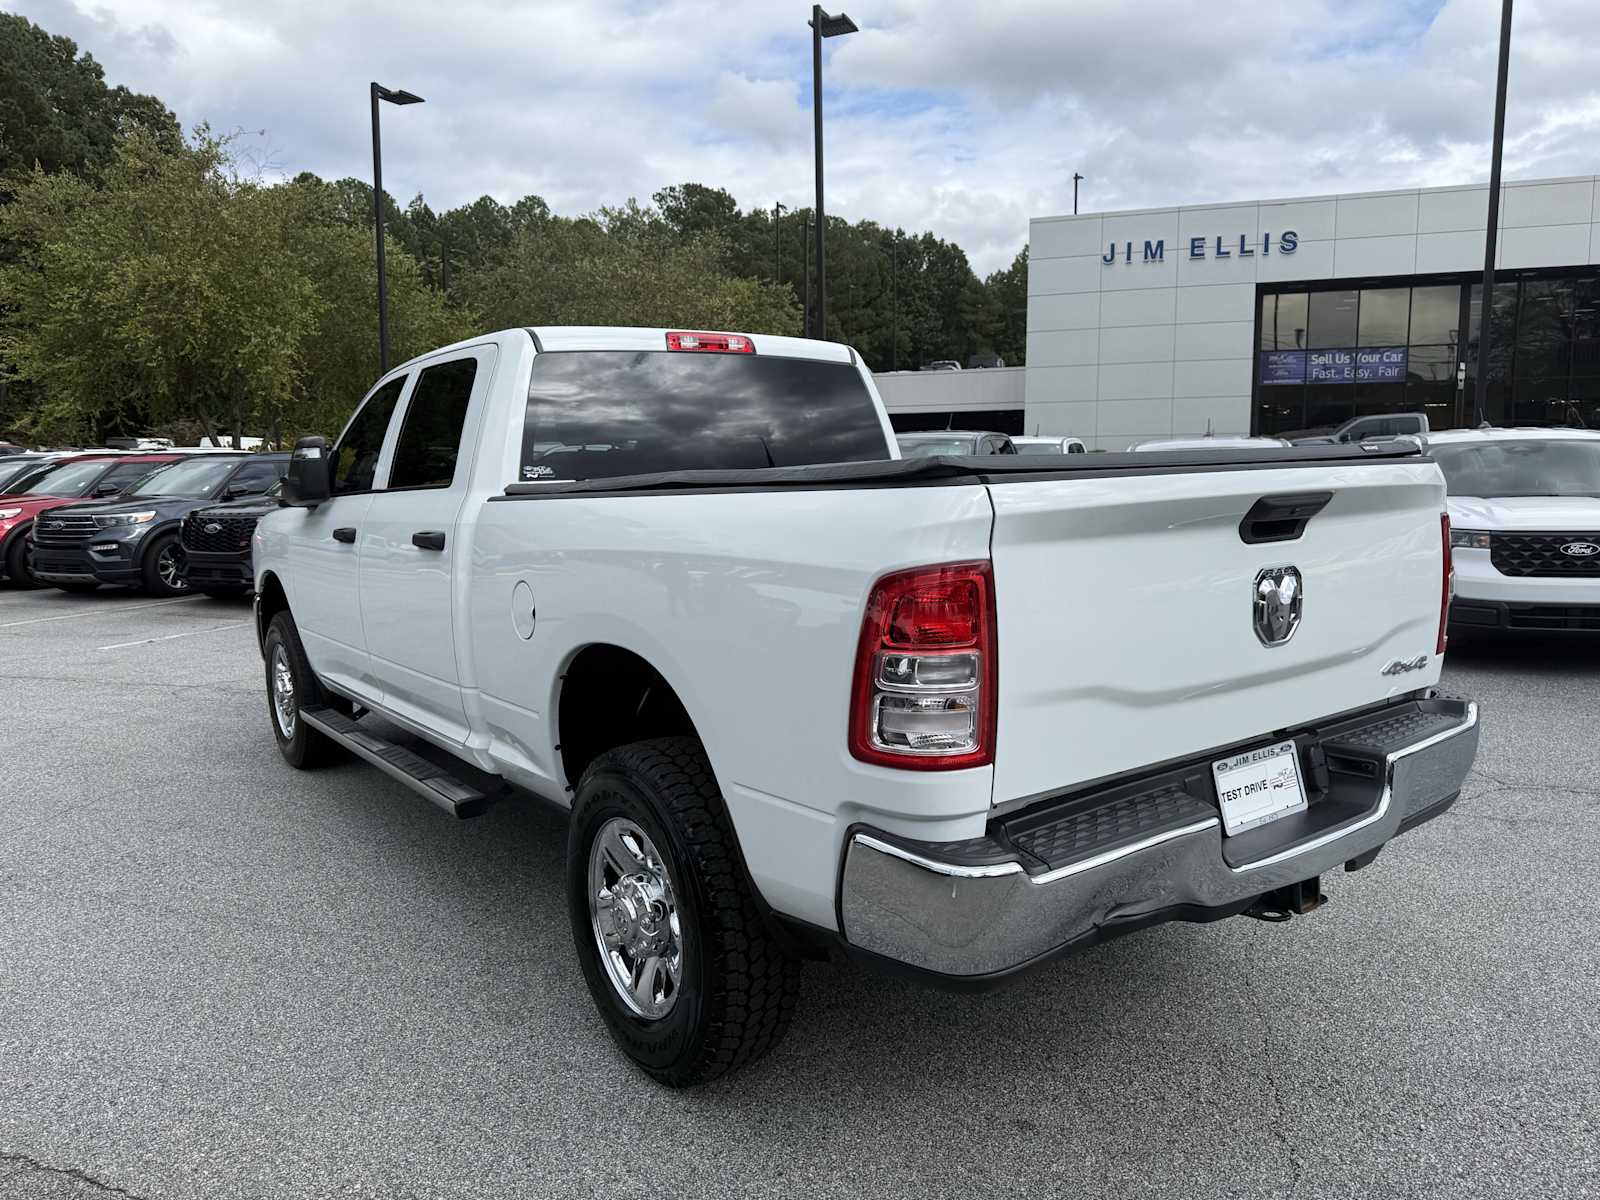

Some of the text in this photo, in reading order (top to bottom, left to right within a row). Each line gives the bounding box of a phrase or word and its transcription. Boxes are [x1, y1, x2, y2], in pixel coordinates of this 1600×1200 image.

[1103, 231, 1298, 265] JIM ELLIS
[1311, 351, 1403, 365] Sell Us Your Car
[1312, 368, 1339, 379] Fast.
[1378, 367, 1399, 377] Fair
[1234, 755, 1249, 767] JIM
[1252, 748, 1276, 761] ELLIS
[1221, 779, 1268, 803] TEST DRIVE
